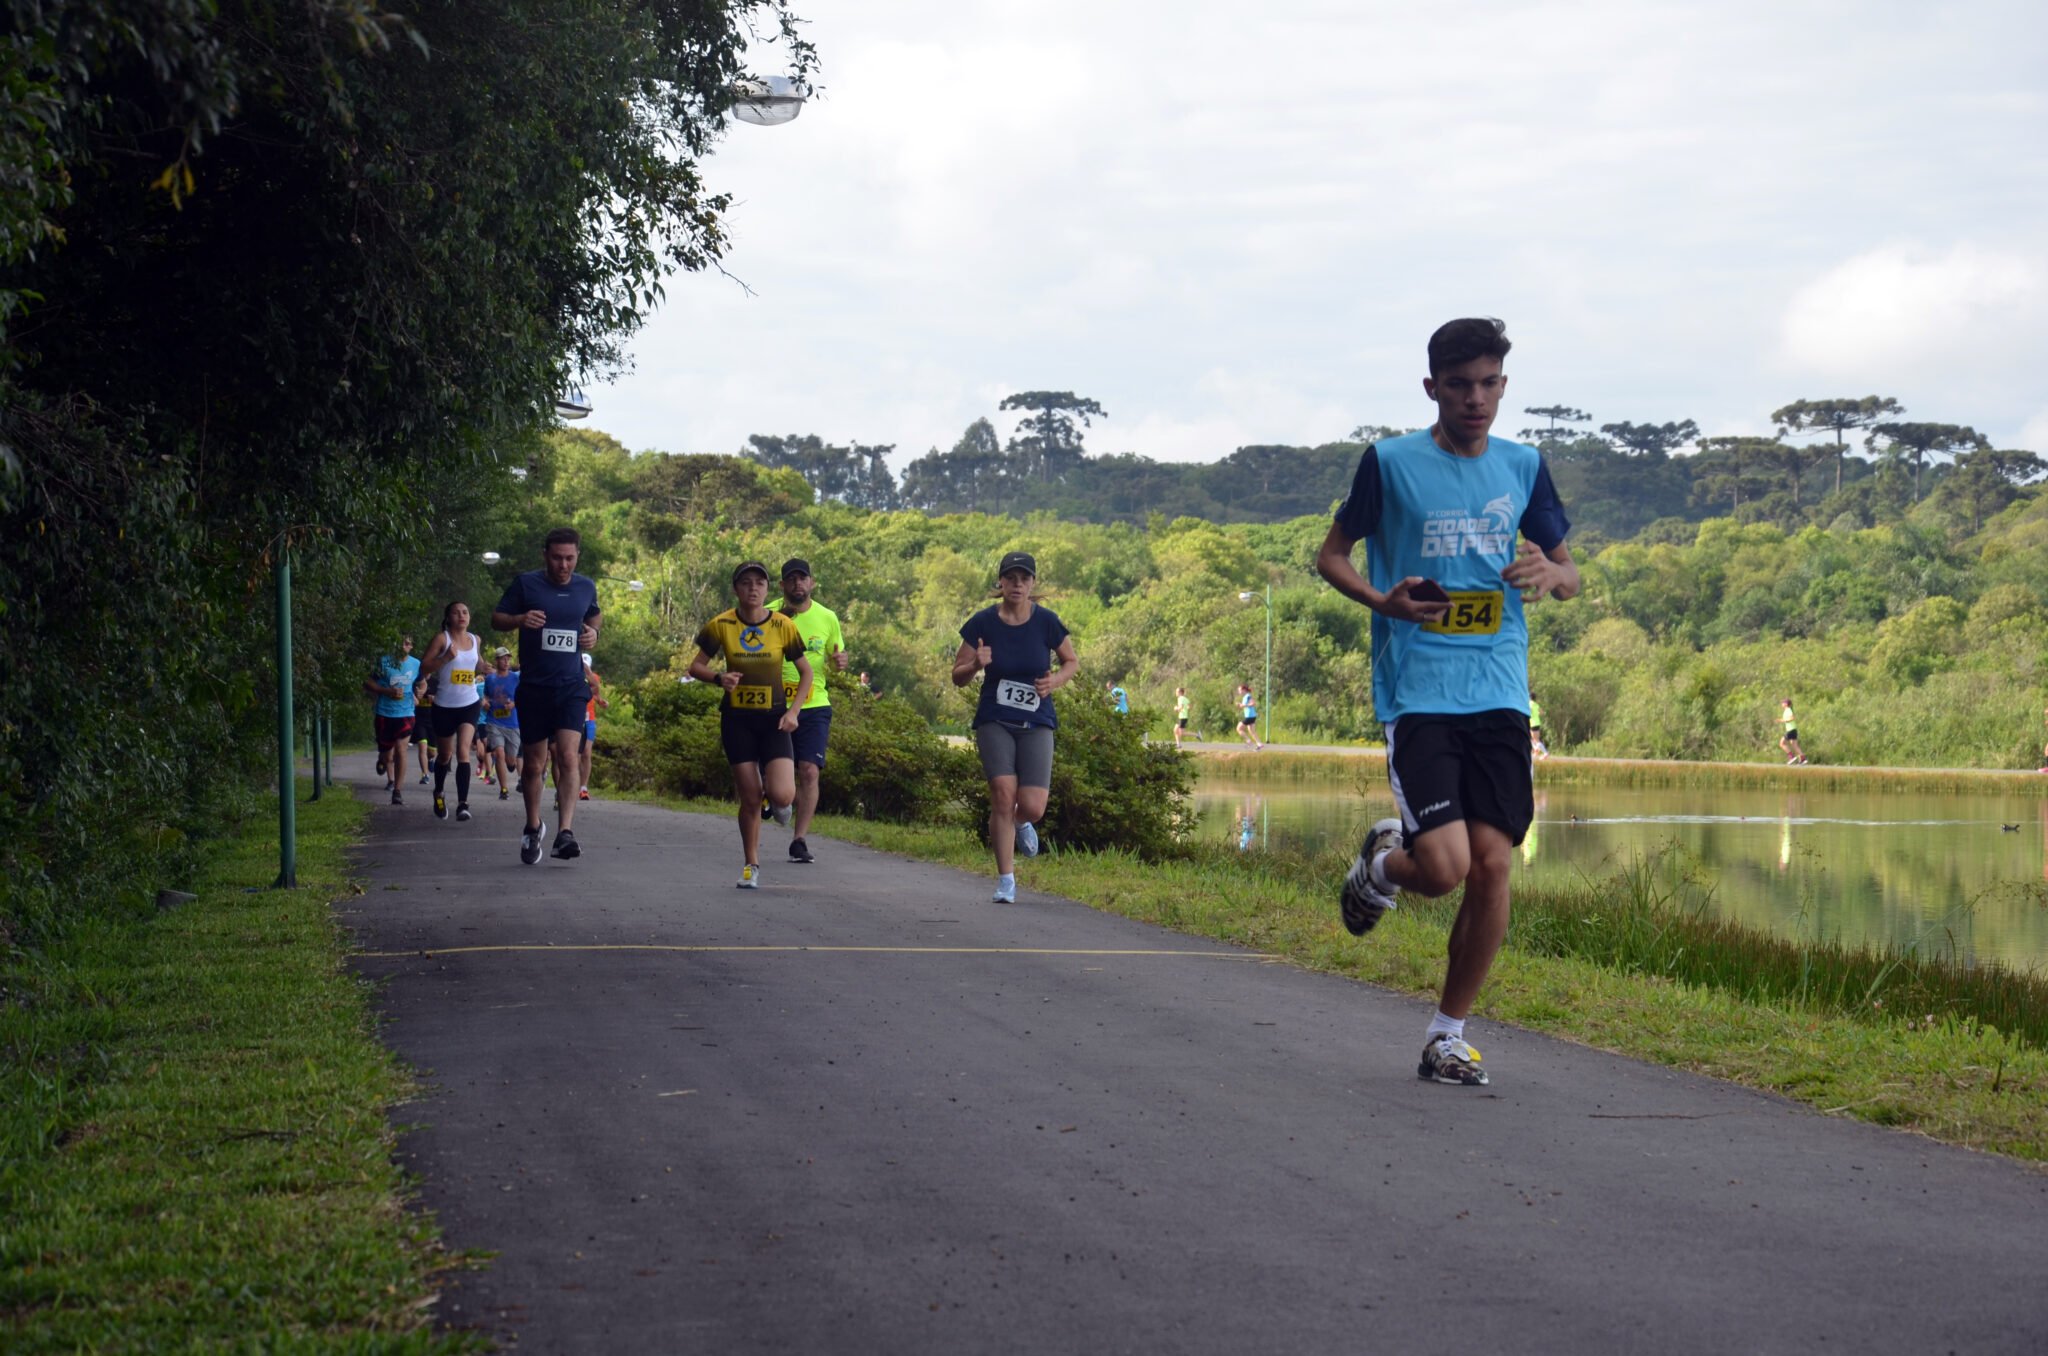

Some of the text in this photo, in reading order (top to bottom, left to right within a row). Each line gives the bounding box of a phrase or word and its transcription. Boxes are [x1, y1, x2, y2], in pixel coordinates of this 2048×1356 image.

[1435, 510, 1469, 518] CORRIDA
[1424, 519, 1490, 535] CIDADE
[1421, 536, 1458, 557] DE
[1442, 603, 1493, 627] 154
[547, 634, 573, 647] 078
[455, 673, 473, 683] 125
[736, 691, 766, 705] 123
[1005, 688, 1035, 705] 132
